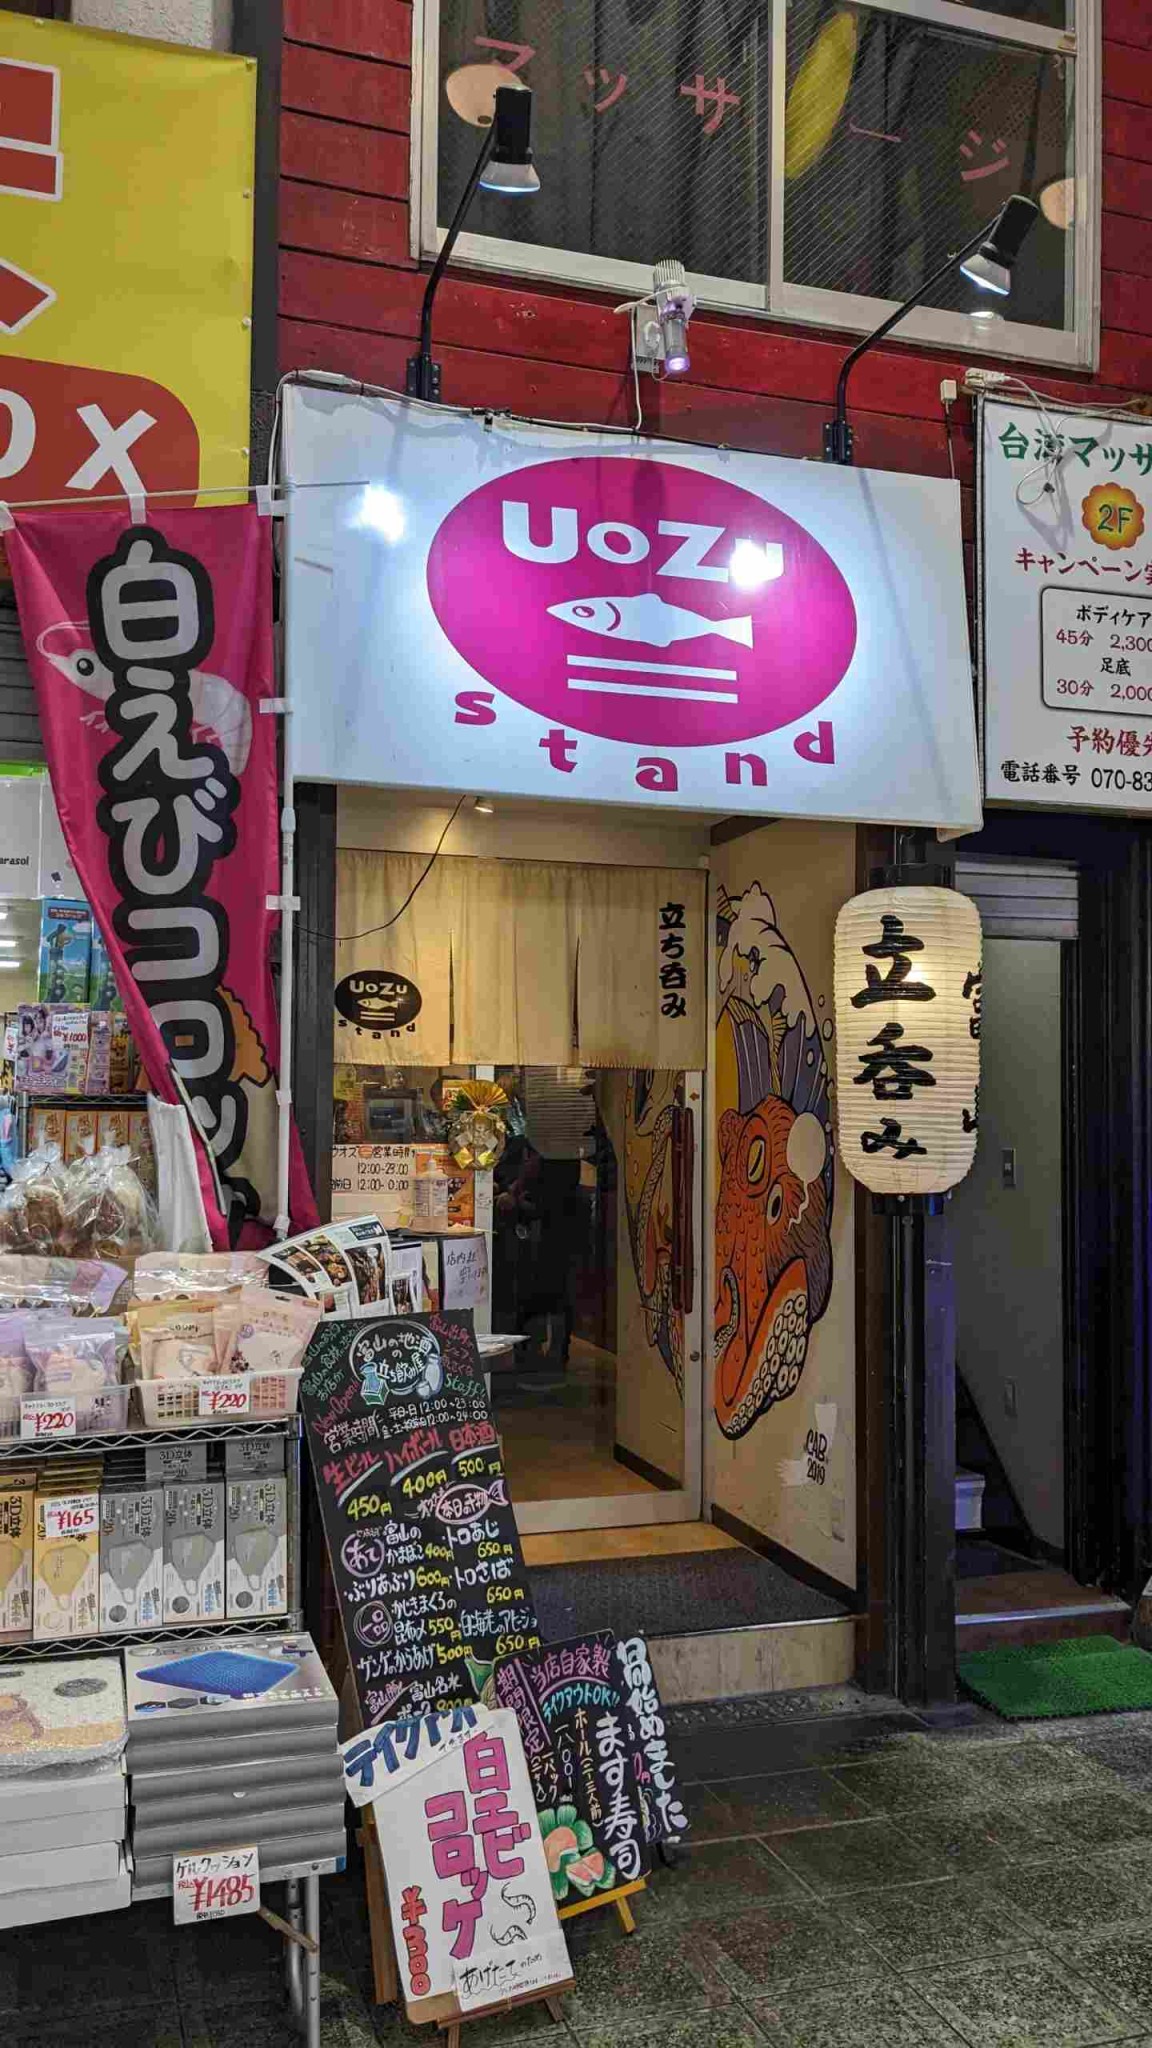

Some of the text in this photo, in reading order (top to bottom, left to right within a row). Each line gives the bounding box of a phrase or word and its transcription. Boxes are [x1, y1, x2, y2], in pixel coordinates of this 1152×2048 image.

[1098, 504, 1133, 534] 2F
[502, 500, 784, 585] UoZu
[1076, 605, 1152, 628] ボディケア
[1056, 628, 1094, 647] 45分
[1100, 657, 1132, 676] 足底
[1056, 679, 1095, 696] 30分
[454, 691, 835, 791] stand
[1000, 760, 1081, 786] 電話番号
[101, 540, 246, 1215] 白えびコロッ
[658, 901, 686, 1019] 立ち呑み
[348, 979, 408, 995] UoZu
[338, 1019, 416, 1039] stand
[208, 1391, 247, 1409] ¥220
[34, 1412, 74, 1431] ¥220
[449, 1421, 499, 1452] 日本酒
[807, 1458, 826, 1486] 2019
[347, 1495, 392, 1521] 450円
[402, 1469, 447, 1498] 400円
[58, 1508, 95, 1530] ¥165
[530, 1643, 611, 1694] 当店自家製
[463, 1731, 532, 1880] 白エビ
[596, 1711, 642, 1879] ます寿司
[176, 1853, 254, 1878] ゲルクッション
[424, 1790, 489, 1960] コロッケ
[187, 1873, 257, 1911] ¥1485
